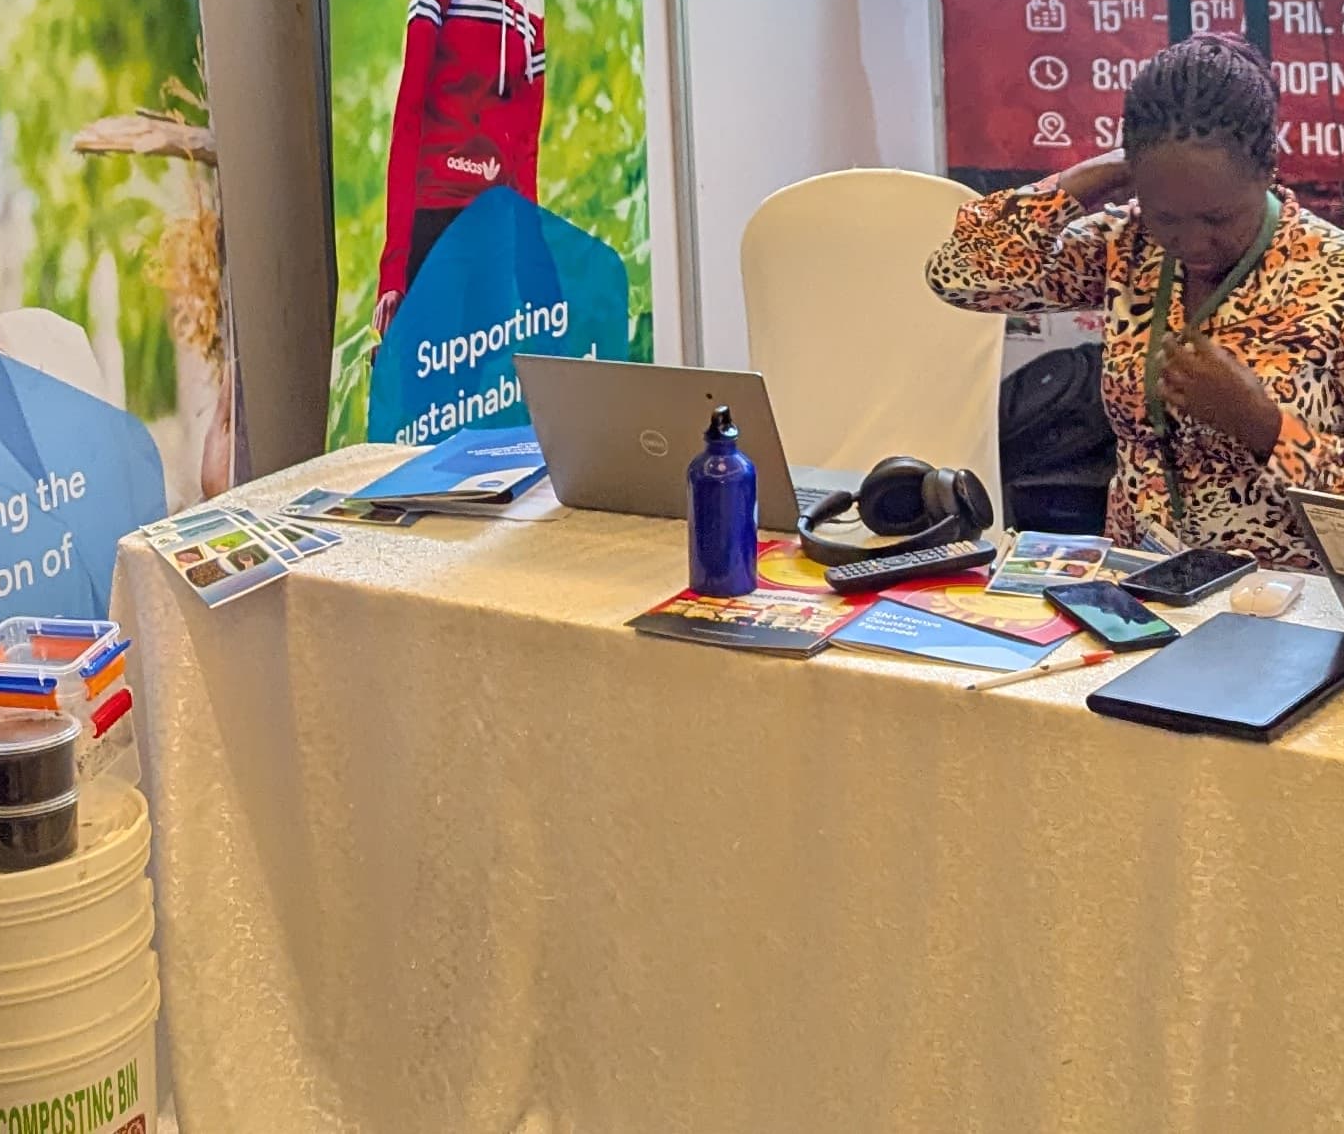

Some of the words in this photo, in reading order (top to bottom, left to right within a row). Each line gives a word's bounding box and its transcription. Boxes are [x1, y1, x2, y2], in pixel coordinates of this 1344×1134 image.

[1191, 0, 1234, 33] 6TH
[447, 156, 483, 176] adidas
[417, 300, 569, 379] Supporting
[395, 374, 523, 445] sustainabl
[36, 471, 86, 513] the
[42, 531, 73, 578] of
[117, 1058, 139, 1115] BIN
